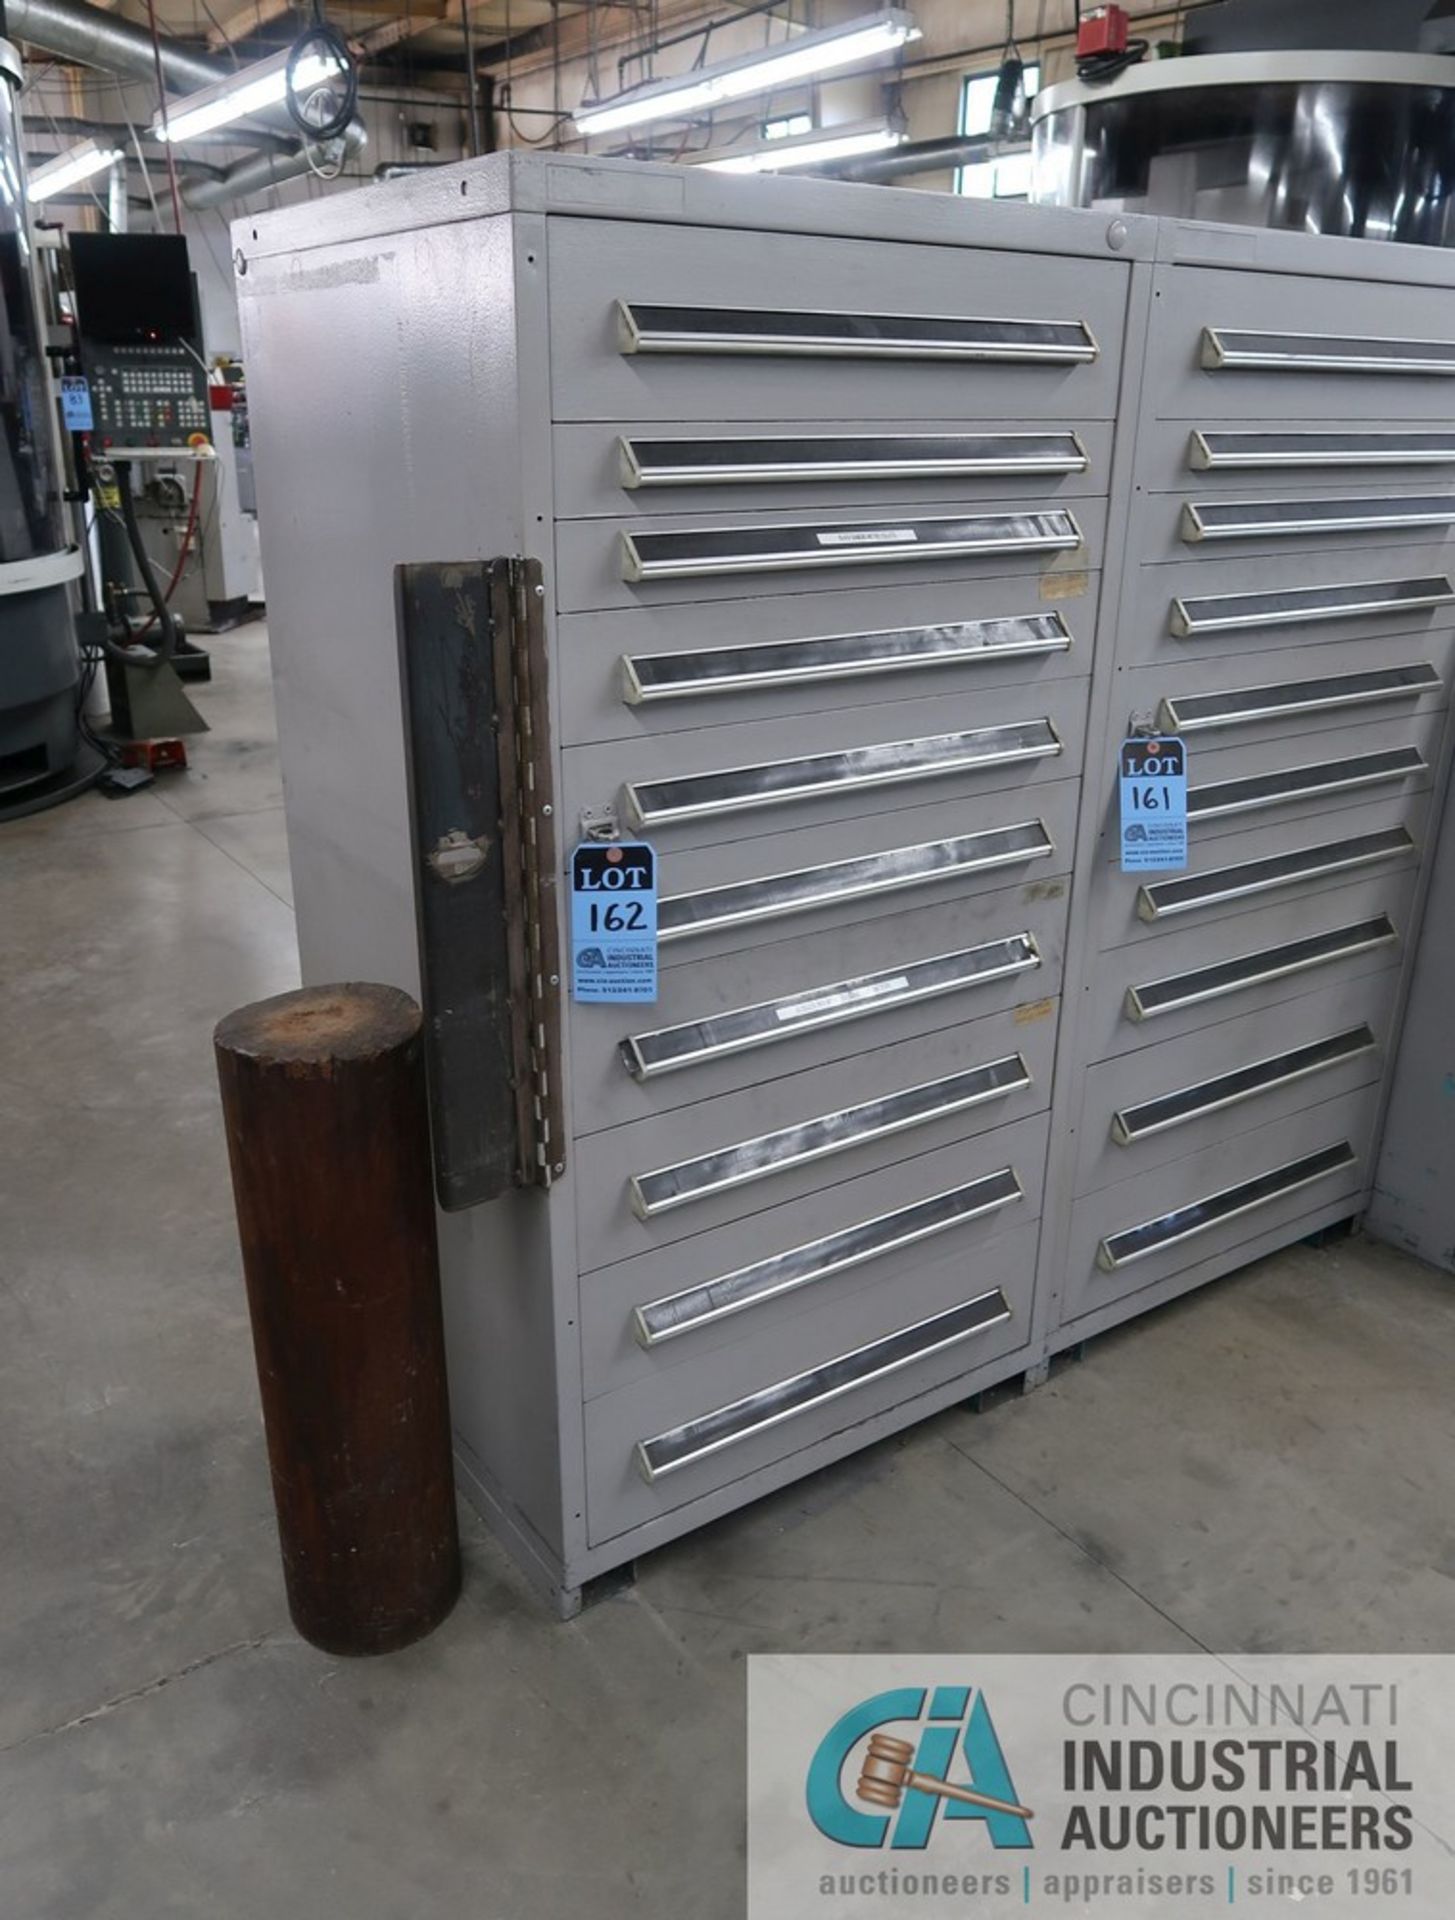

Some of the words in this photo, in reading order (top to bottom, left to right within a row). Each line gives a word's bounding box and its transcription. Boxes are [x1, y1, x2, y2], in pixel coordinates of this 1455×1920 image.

[1128, 757, 1179, 776] LOT
[1132, 786, 1170, 811] 161
[580, 867, 647, 890] LOT
[590, 901, 648, 932] 162
